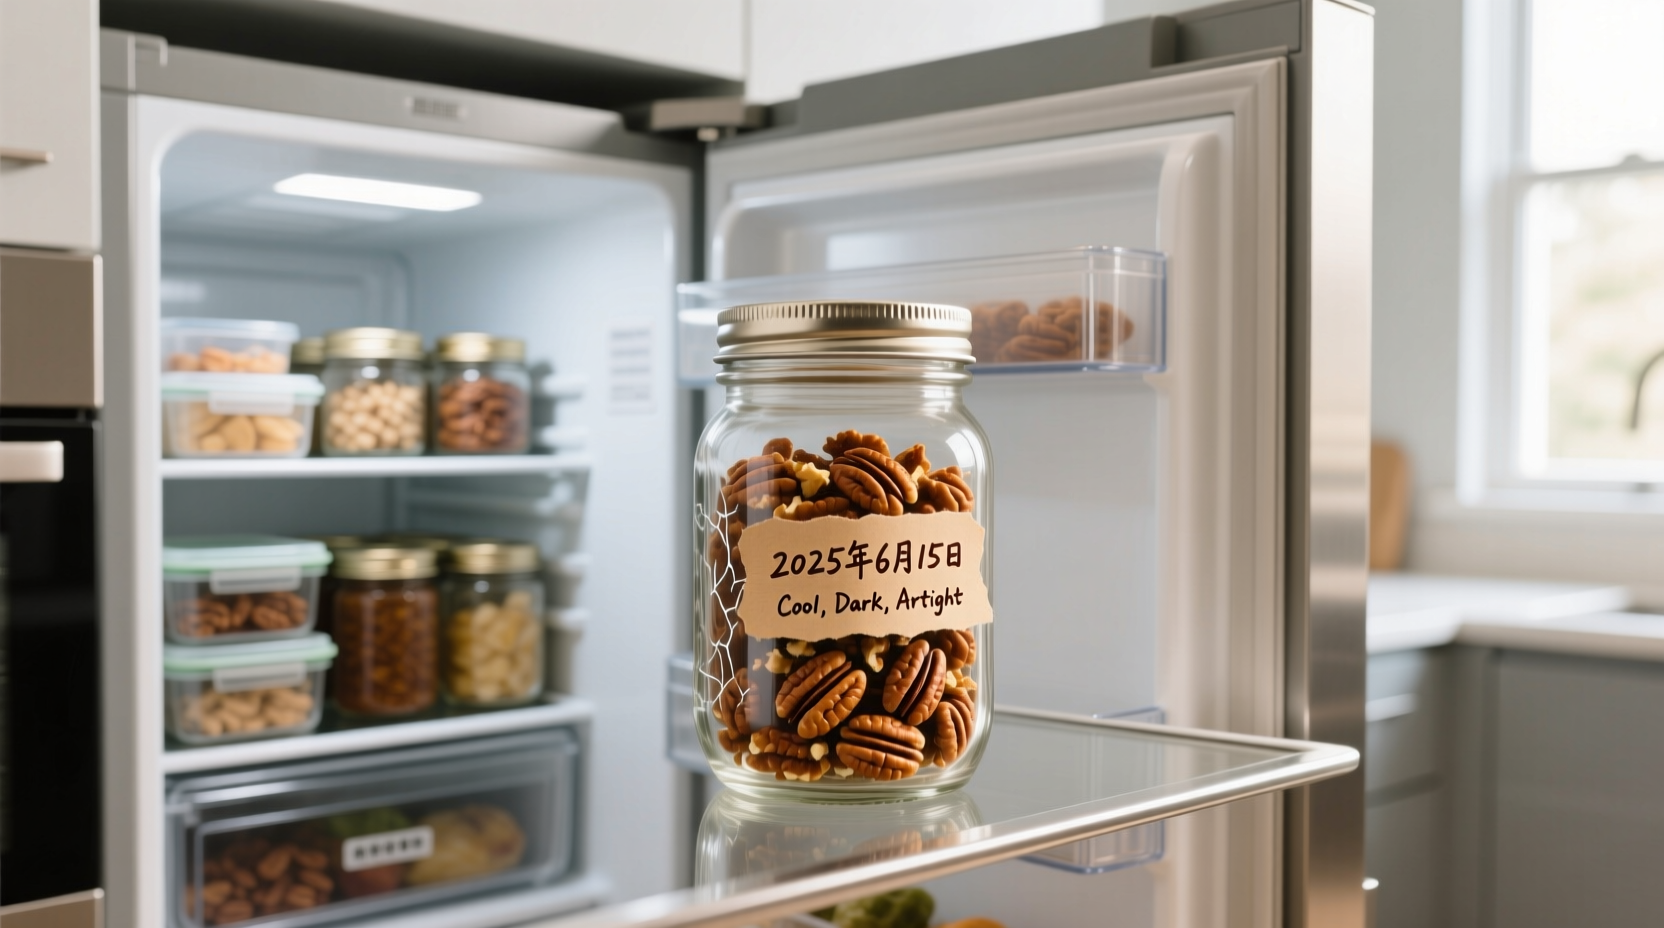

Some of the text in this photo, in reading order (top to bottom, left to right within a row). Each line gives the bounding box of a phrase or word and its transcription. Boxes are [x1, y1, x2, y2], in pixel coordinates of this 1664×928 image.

[770, 540, 961, 579] 2025年6月15日
[777, 587, 963, 618] Cool, Dark, Artight
